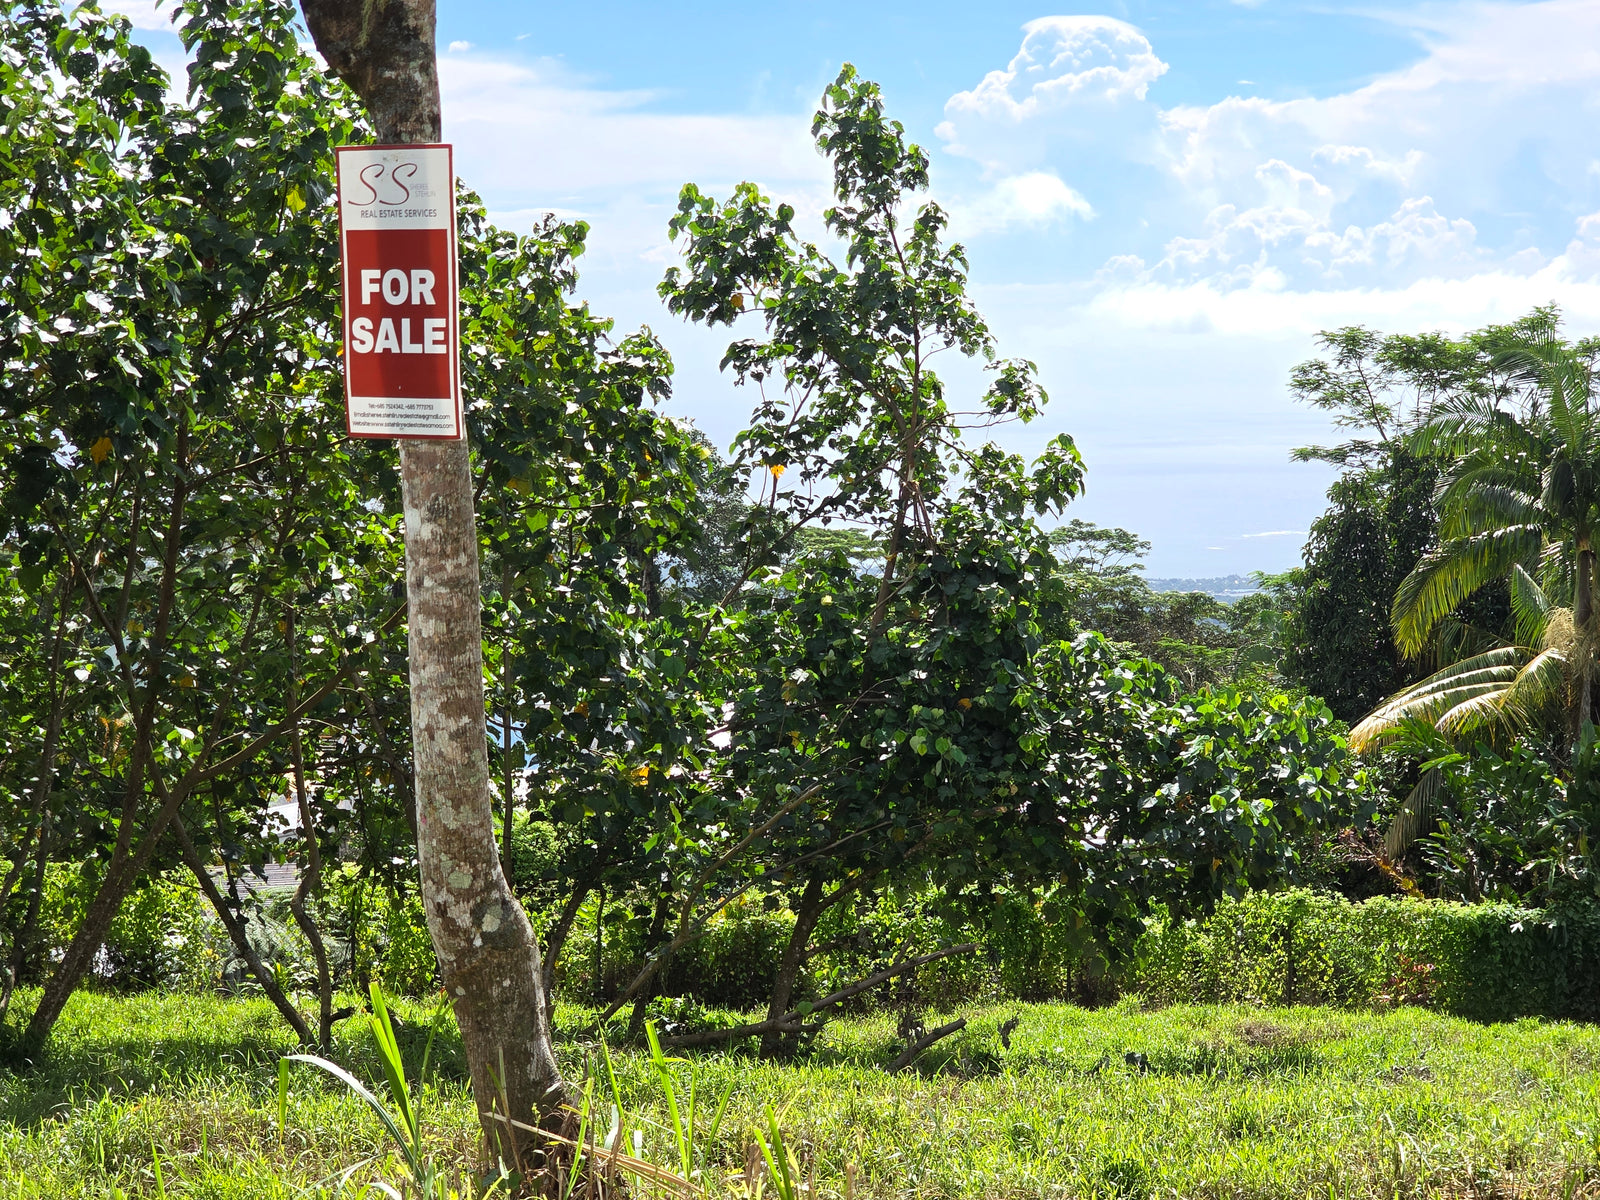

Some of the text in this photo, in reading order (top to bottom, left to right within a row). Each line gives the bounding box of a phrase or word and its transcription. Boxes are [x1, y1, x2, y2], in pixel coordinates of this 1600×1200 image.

[360, 208, 437, 219] REAL ESTATE SERVICES
[361, 268, 436, 306] FOR
[351, 316, 447, 354] SALE
